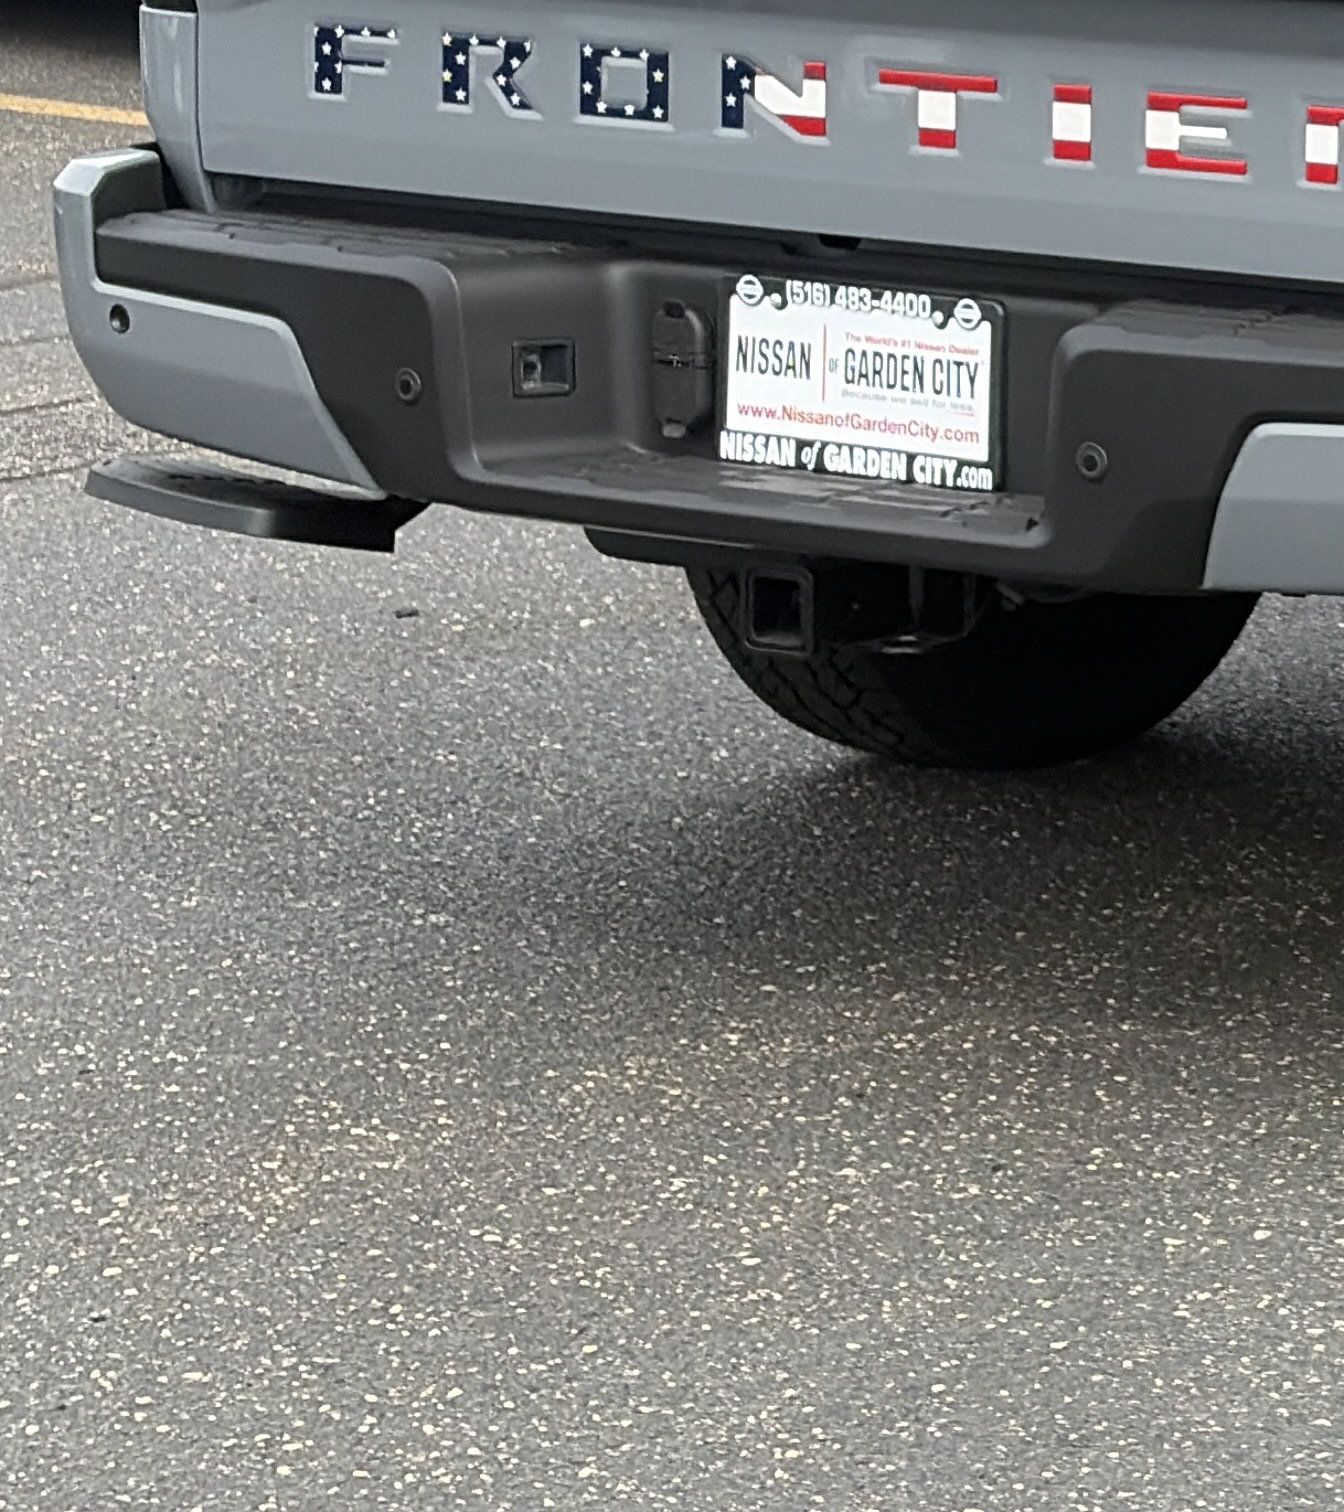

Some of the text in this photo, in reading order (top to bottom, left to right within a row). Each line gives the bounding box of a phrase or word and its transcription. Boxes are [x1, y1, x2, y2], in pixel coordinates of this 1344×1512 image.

[785, 279, 932, 319] (516) 483-4400
[736, 334, 812, 381] NISSAN
[828, 347, 979, 400] OF GARDEN CITY
[737, 403, 980, 443] www.NissanofGardenCity.com
[719, 430, 994, 491] NISSAN of GARDEN CITY.com
